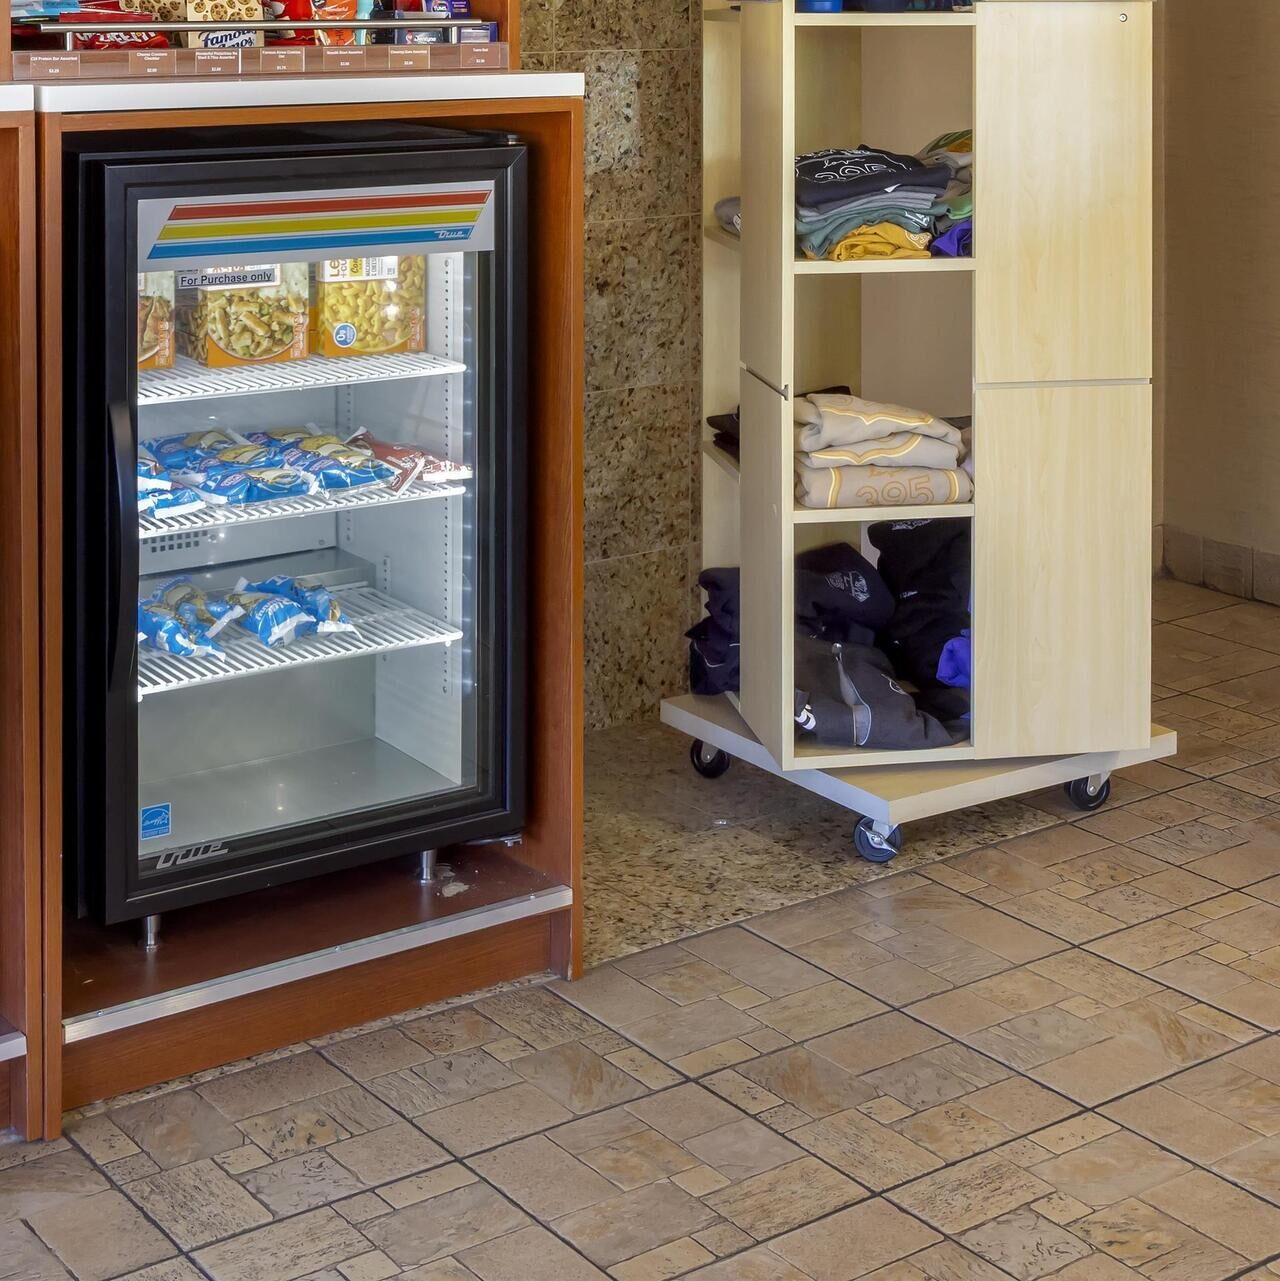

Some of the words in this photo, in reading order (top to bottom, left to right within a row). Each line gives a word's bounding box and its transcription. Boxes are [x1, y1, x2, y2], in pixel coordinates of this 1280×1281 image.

[180, 275, 199, 286] For
[200, 272, 249, 285] Purchase
[251, 271, 272, 282] only
